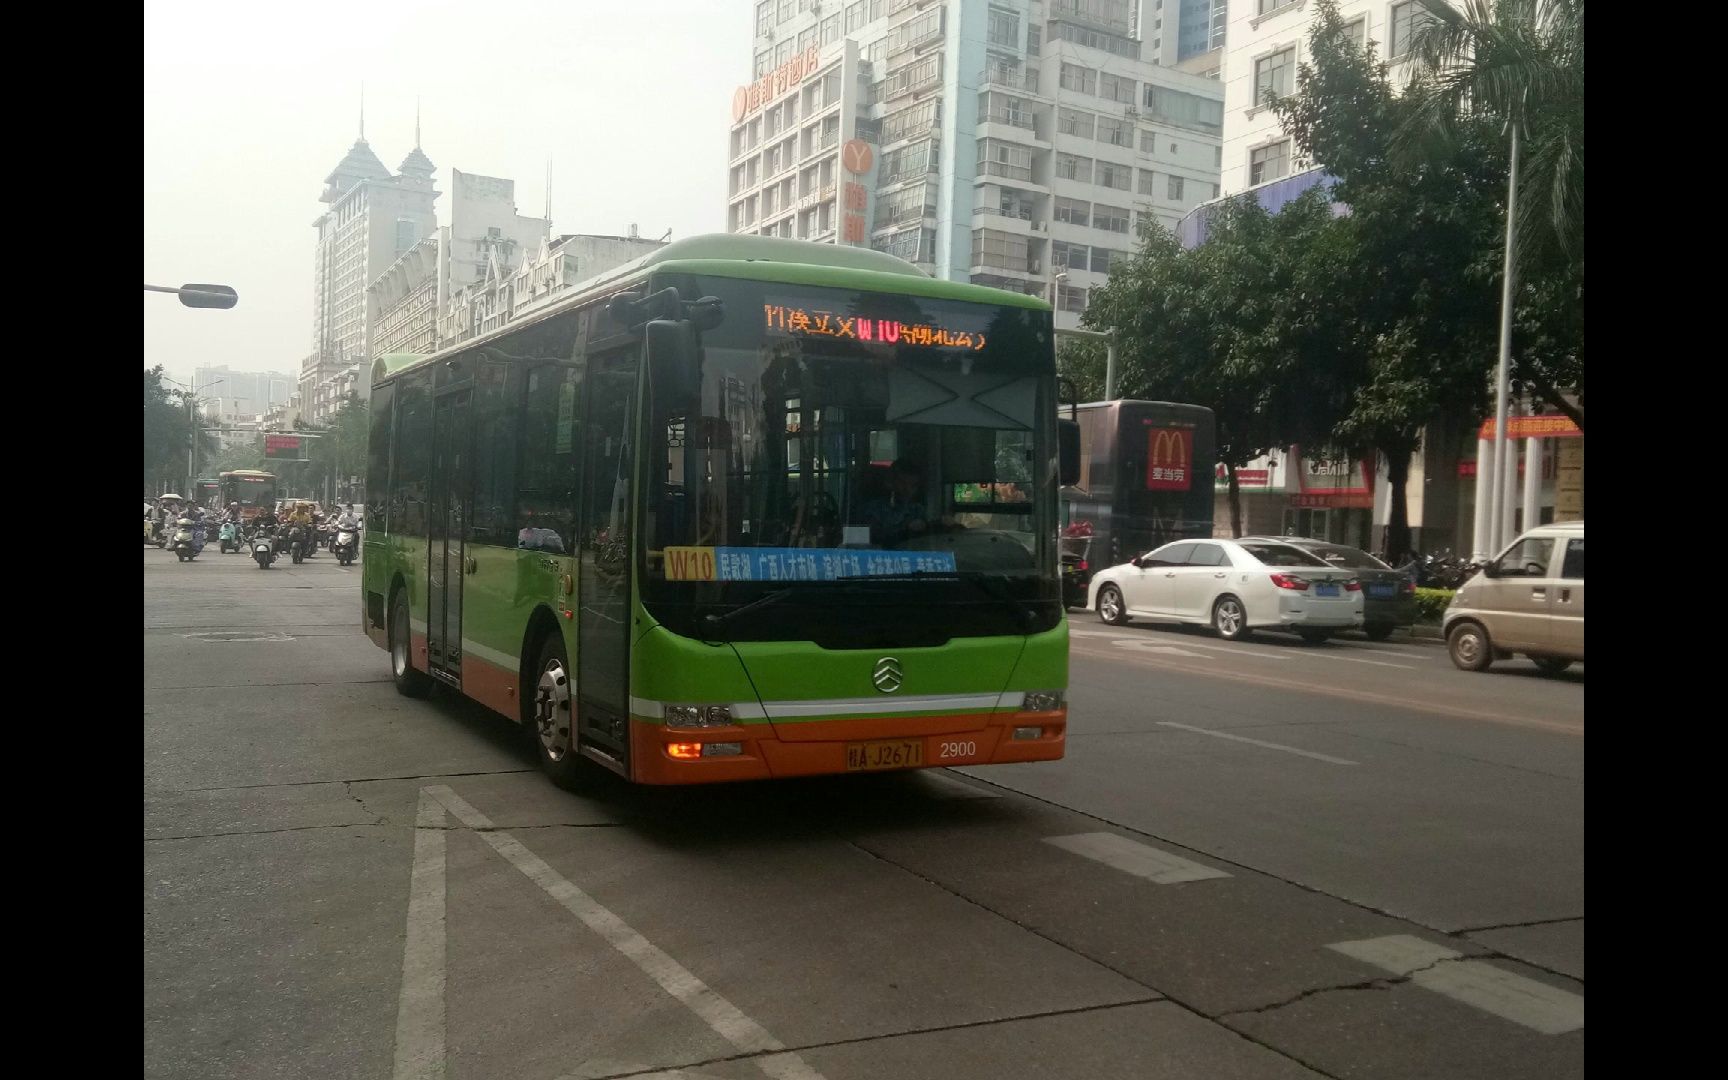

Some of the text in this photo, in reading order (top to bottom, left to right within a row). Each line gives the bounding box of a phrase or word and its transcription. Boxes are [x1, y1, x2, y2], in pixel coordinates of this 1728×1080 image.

[1152, 467, 1185, 482] 麦当劳
[669, 550, 713, 580] W10
[940, 741, 976, 759] 2900
